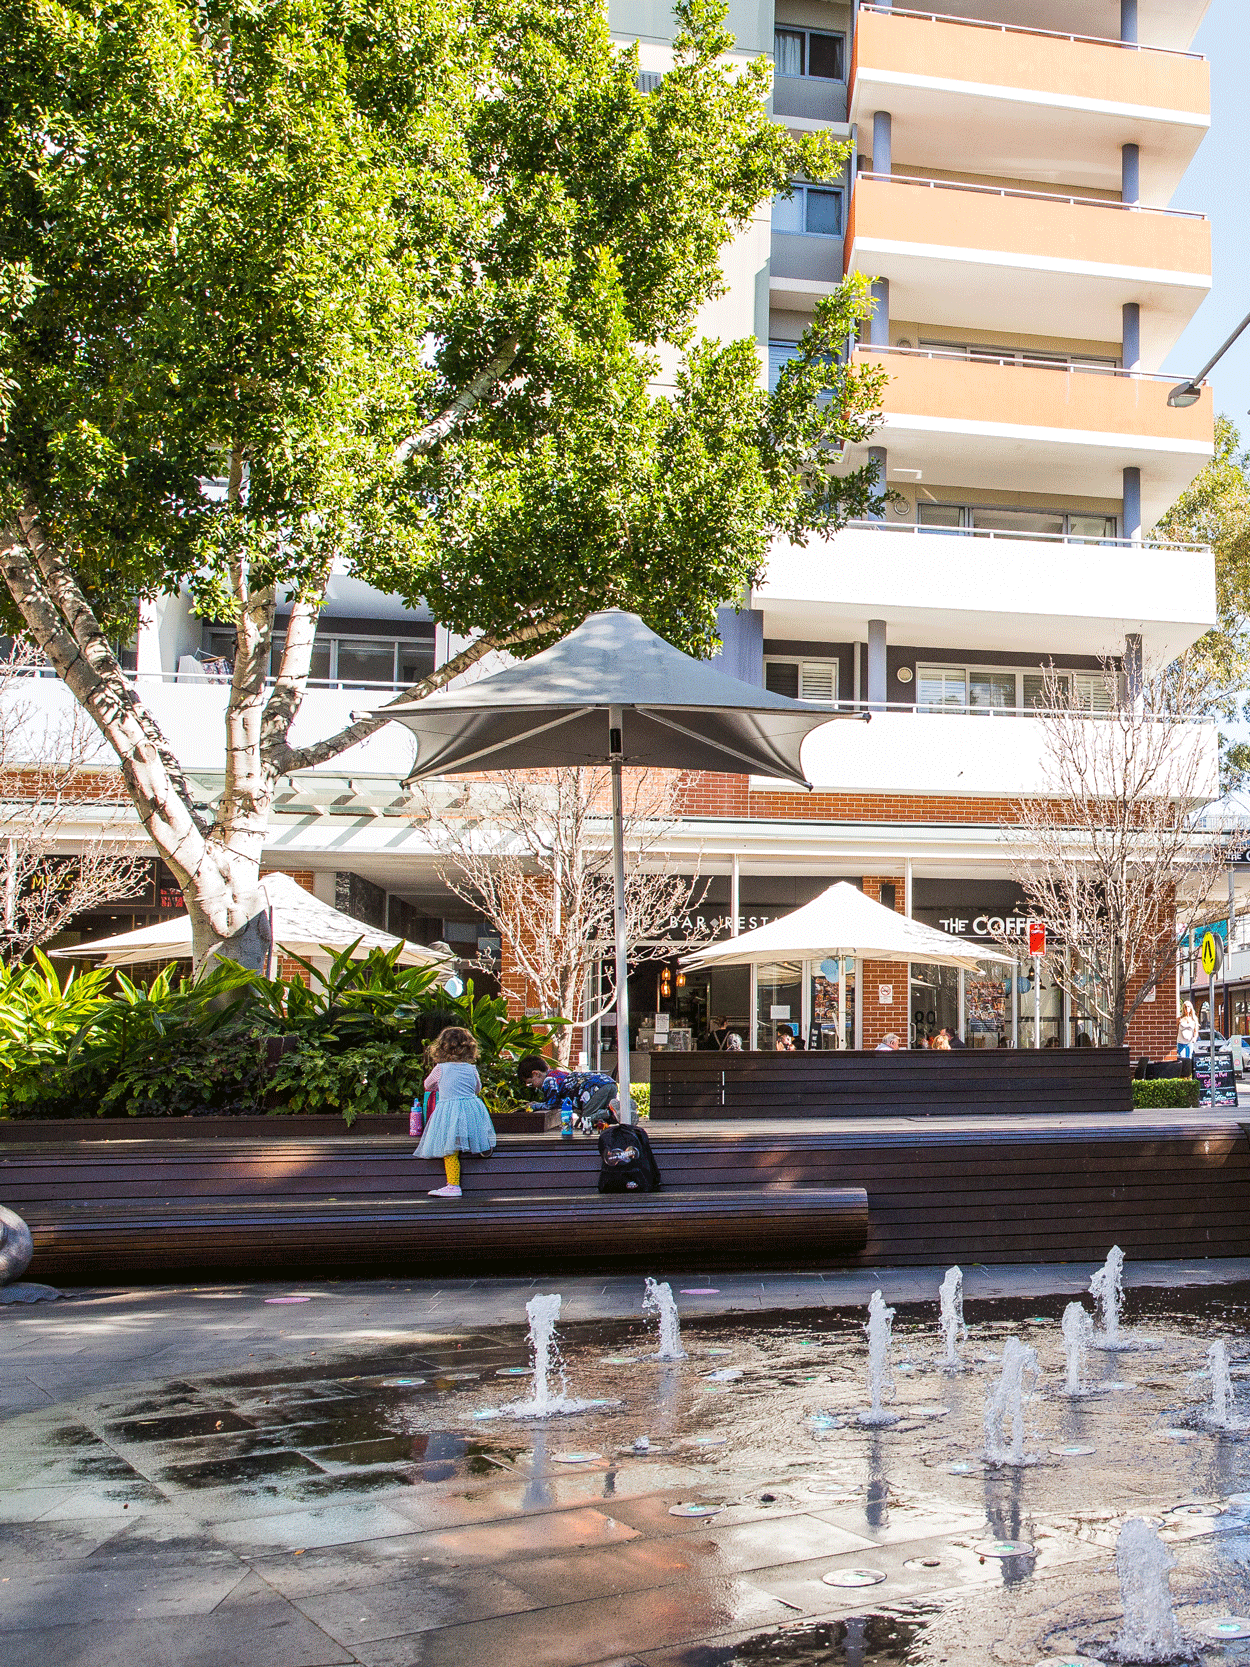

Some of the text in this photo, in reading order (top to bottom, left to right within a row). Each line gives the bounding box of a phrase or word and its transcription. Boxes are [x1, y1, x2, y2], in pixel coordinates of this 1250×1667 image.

[669, 916, 780, 930] BAR REST
[939, 917, 969, 934] THE
